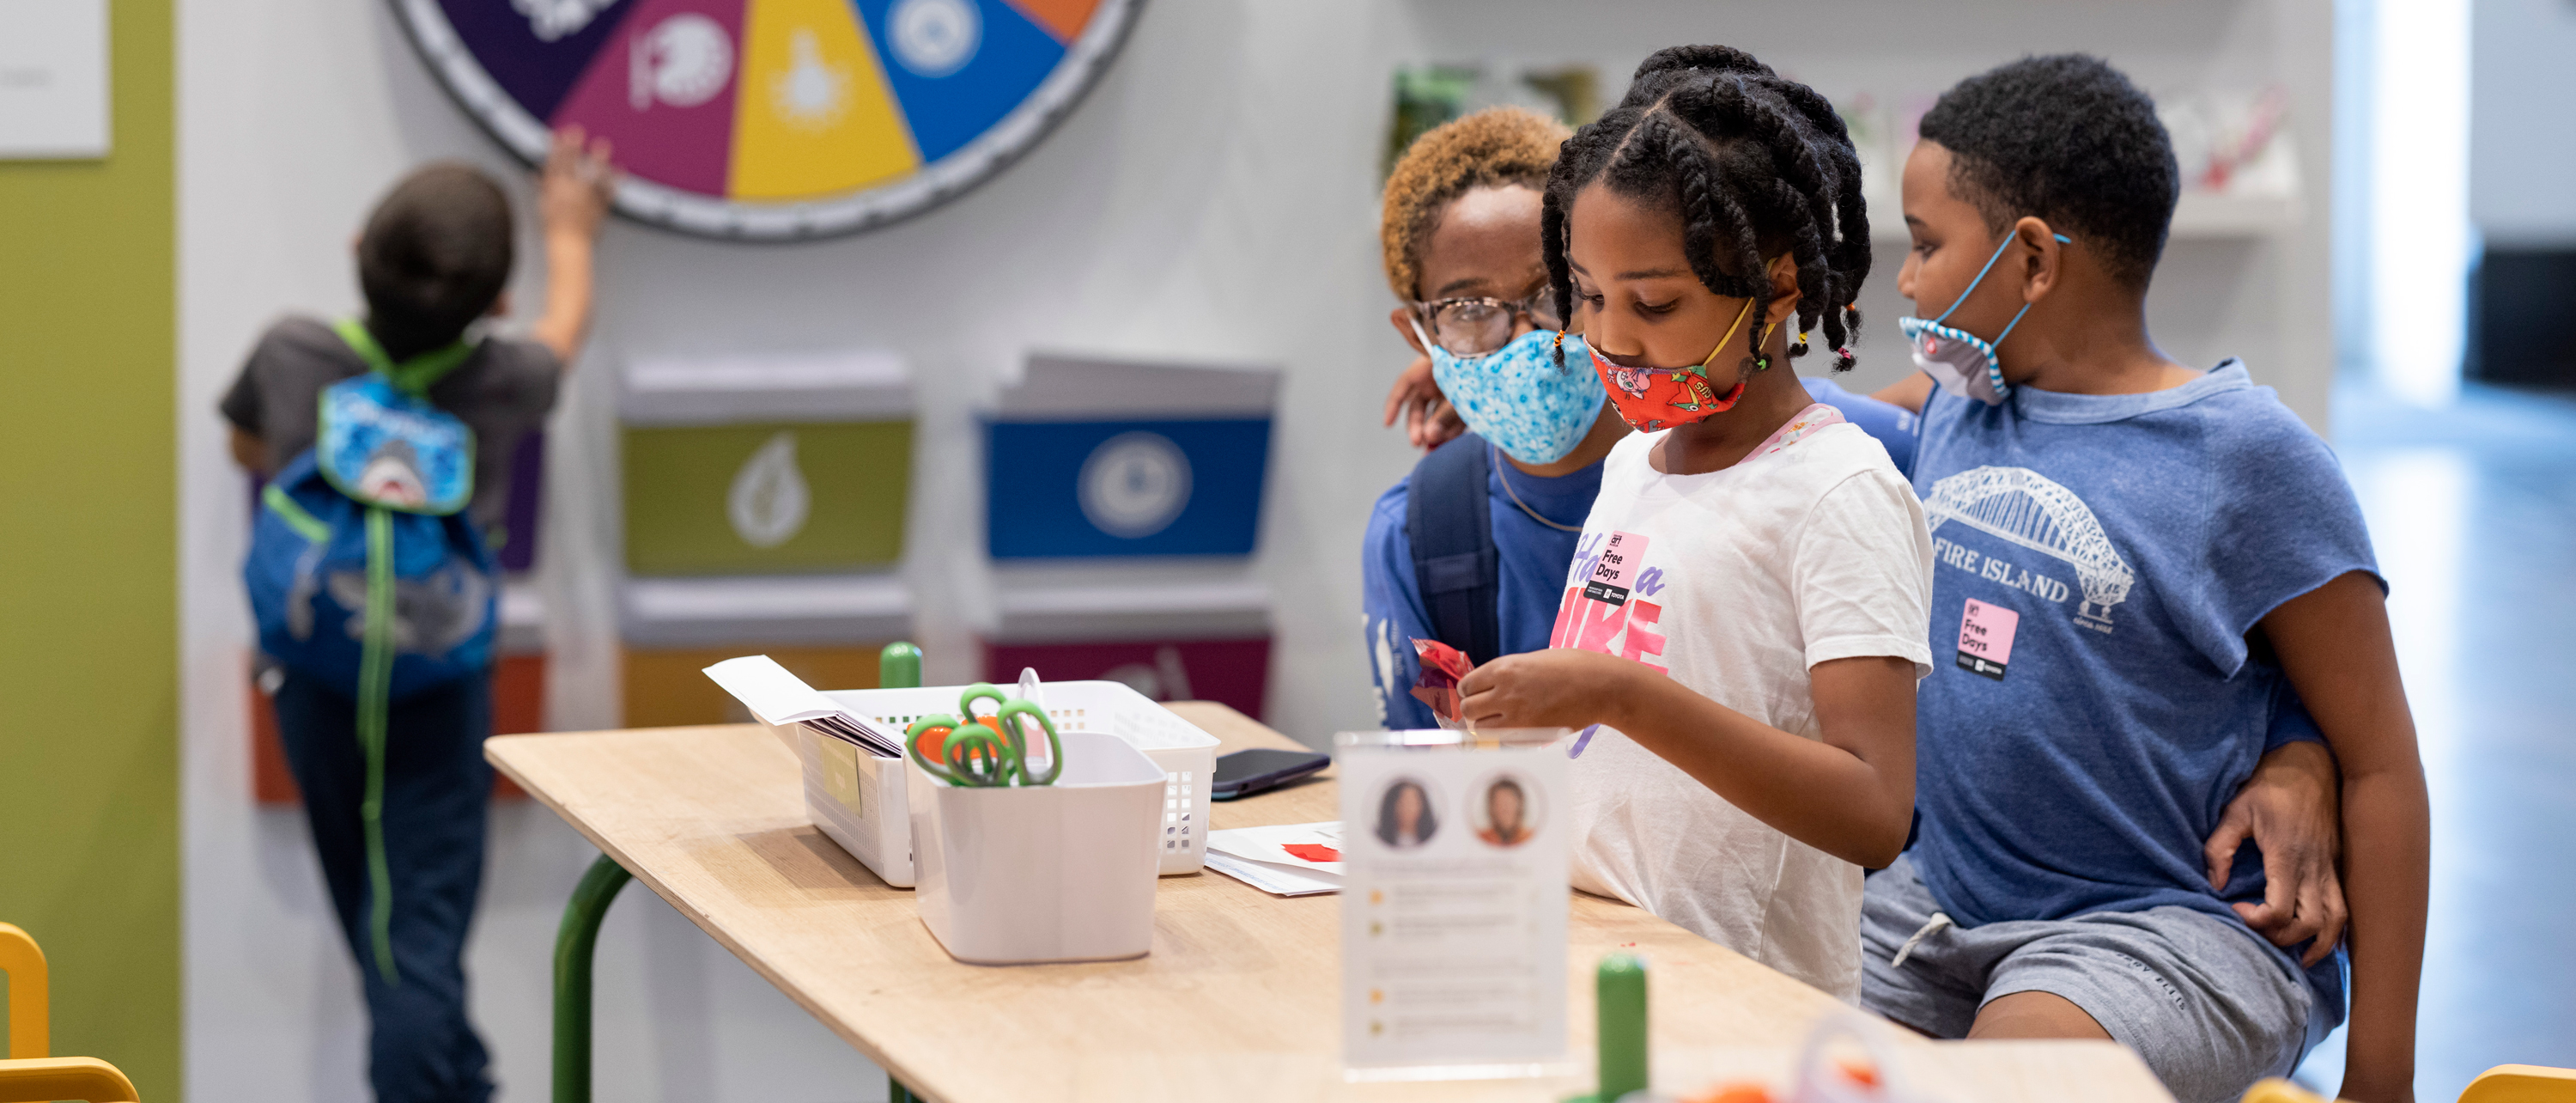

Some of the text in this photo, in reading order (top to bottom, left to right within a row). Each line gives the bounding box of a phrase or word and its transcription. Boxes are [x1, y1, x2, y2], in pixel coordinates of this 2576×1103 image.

[1602, 550, 1623, 565] Free
[1595, 564, 1620, 582] Days
[1933, 537, 2070, 603] FIRE ISLAND
[1635, 566, 1665, 596] a
[1965, 619, 1988, 637] Free
[1962, 633, 1988, 652] Days
